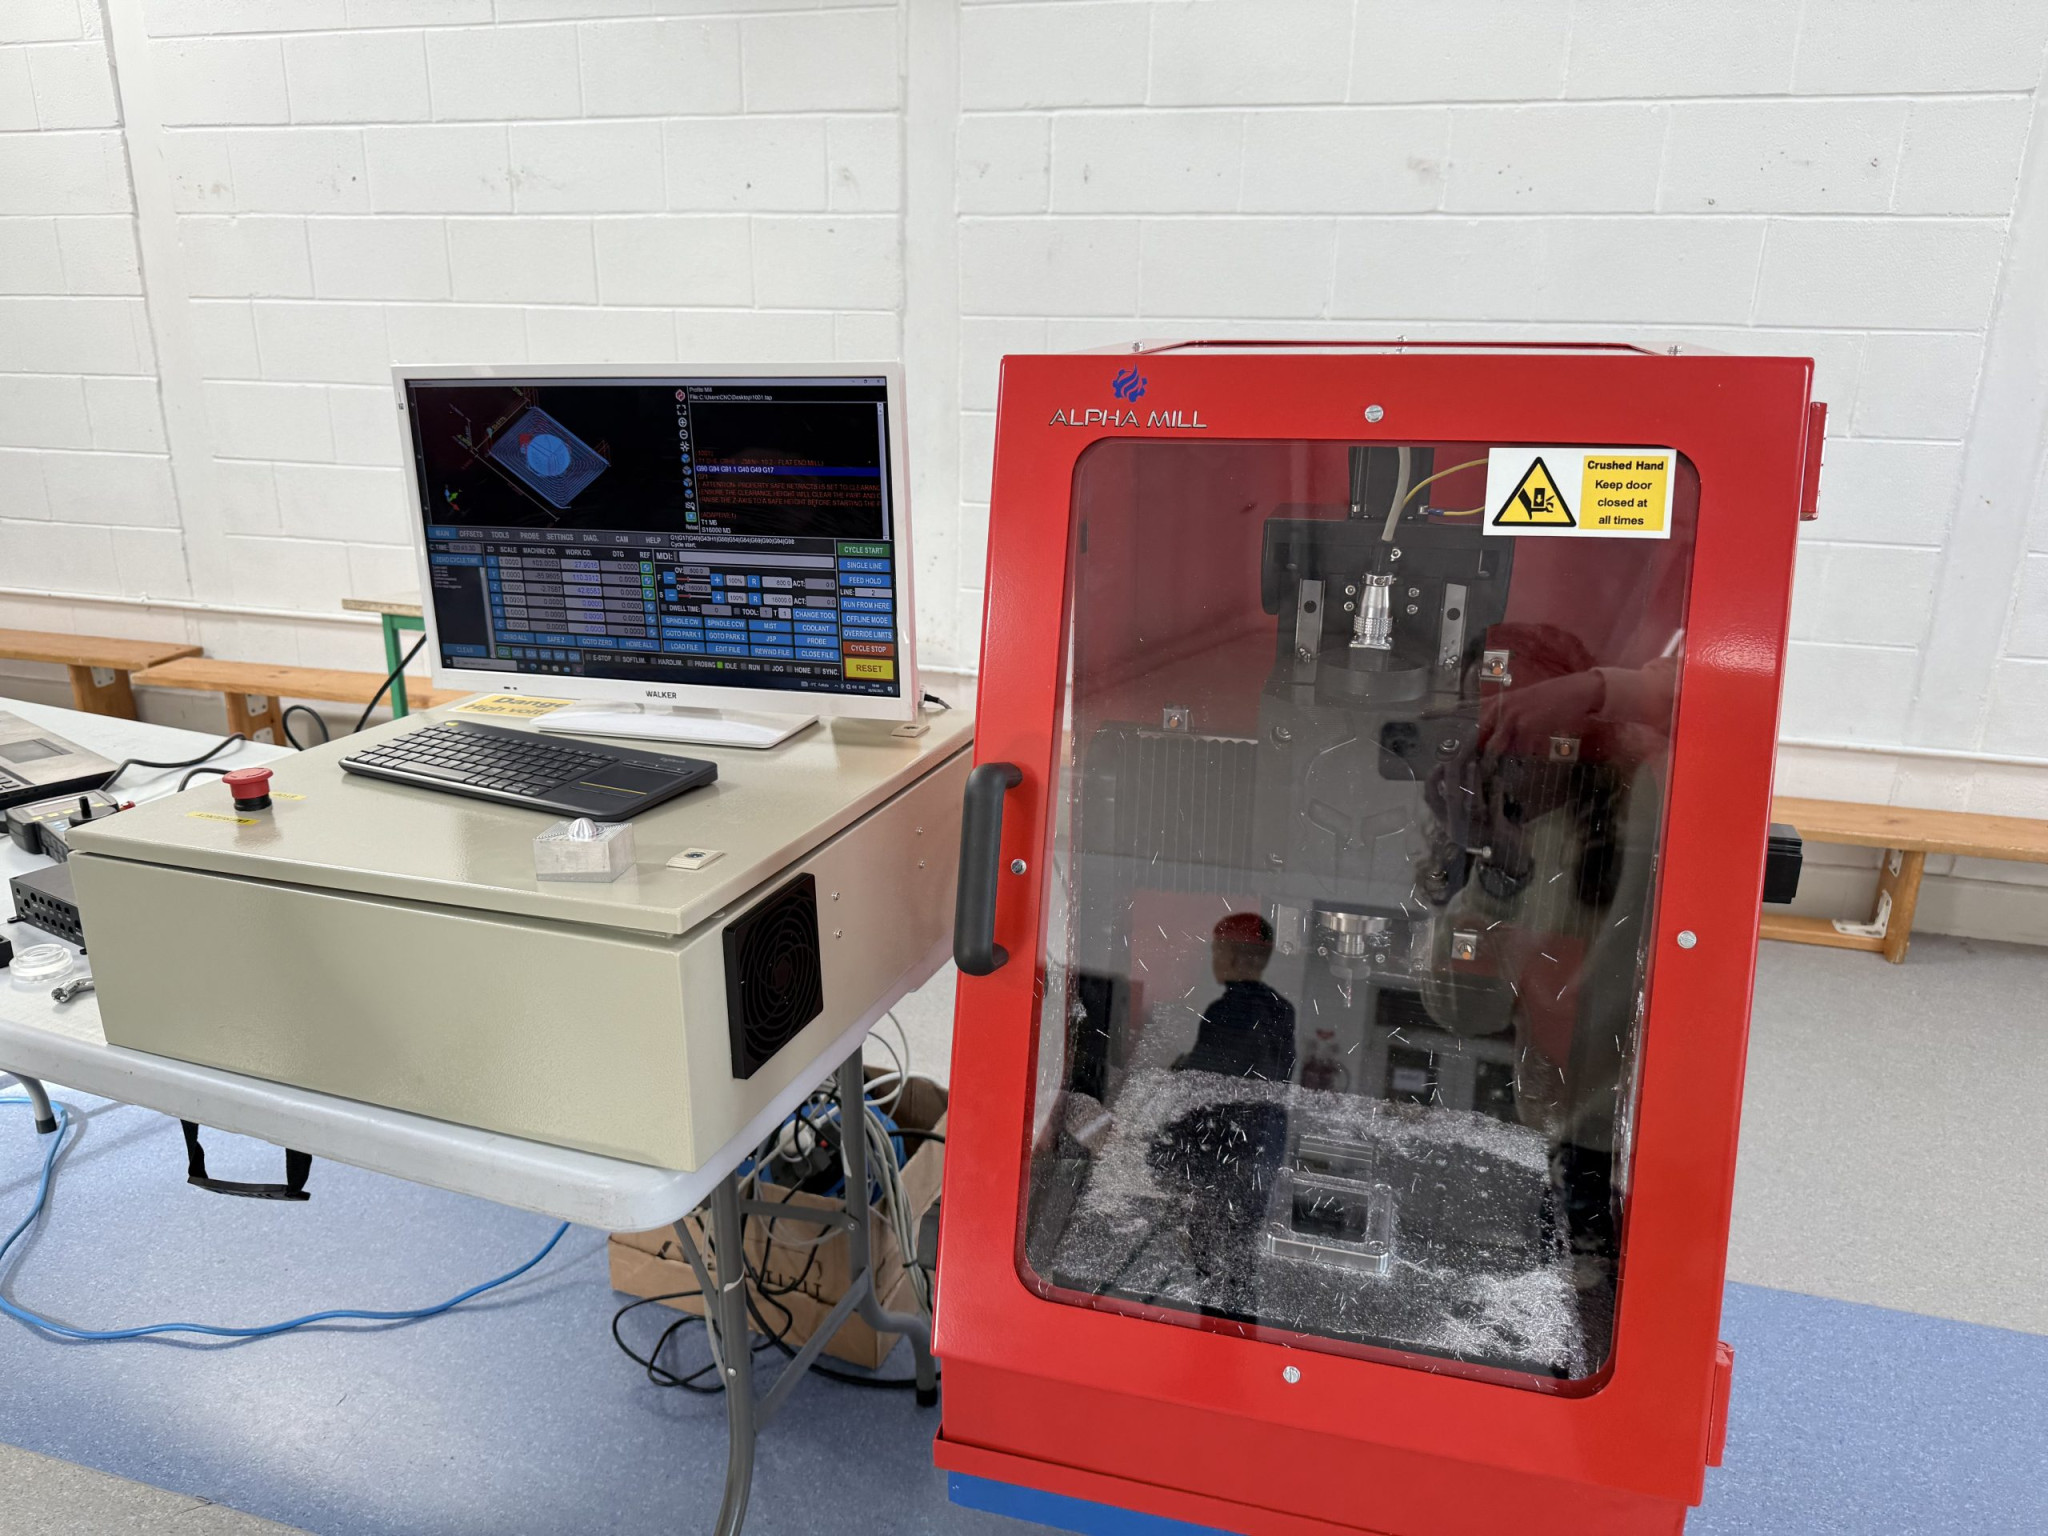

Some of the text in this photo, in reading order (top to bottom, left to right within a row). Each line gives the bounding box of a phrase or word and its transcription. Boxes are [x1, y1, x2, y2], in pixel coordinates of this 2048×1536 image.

[1049, 409, 1207, 428] ALPHA MILL
[1587, 460, 1664, 471] Crushed Hand
[1596, 480, 1652, 491] Keep door
[1597, 498, 1648, 507] closed at
[1599, 515, 1644, 525] all times
[459, 530, 483, 538] OFFSETS
[491, 531, 509, 539] TOOLS
[546, 533, 574, 541] SETTINGS
[844, 546, 883, 555] CYCLE START
[656, 552, 673, 561] MDI:
[865, 577, 882, 585] HOLD
[840, 588, 855, 596] LINE:
[742, 608, 759, 616] TOOL:
[795, 611, 836, 620] CHANGE TOOL
[846, 615, 870, 623] OFFLINE
[843, 631, 892, 640] OVERRIDE LIMITS
[821, 651, 834, 659] FILE
[724, 662, 738, 670] IDLE
[771, 665, 784, 673] JOG
[856, 664, 883, 674] RESET
[822, 668, 840, 676] SYNC.
[645, 690, 677, 699] WALKER
[492, 697, 570, 709] Dange
[464, 704, 506, 713] High
